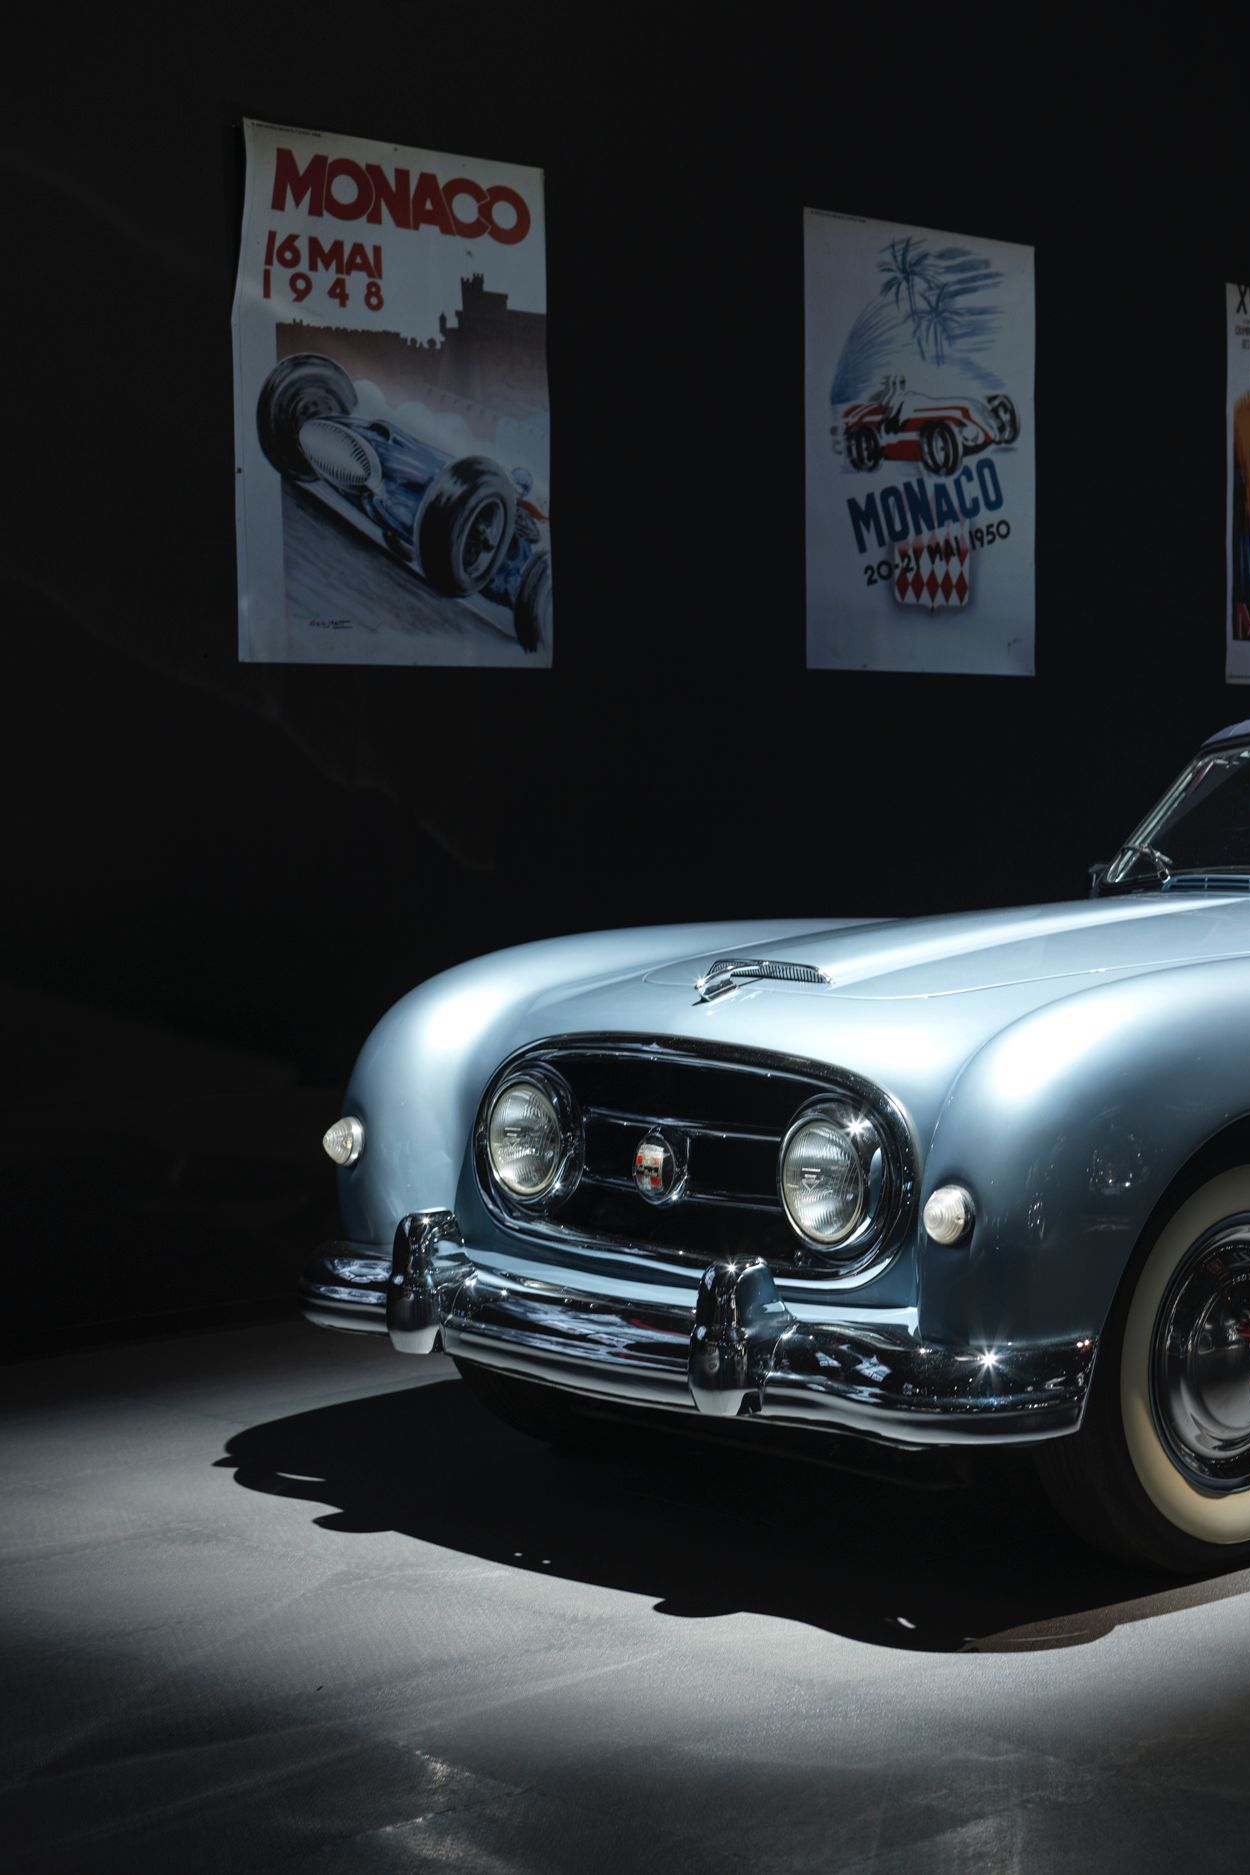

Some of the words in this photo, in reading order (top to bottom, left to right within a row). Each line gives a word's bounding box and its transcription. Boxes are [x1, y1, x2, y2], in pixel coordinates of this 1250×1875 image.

[271, 147, 531, 246] MONACO
[264, 230, 302, 269] 16
[308, 236, 383, 280] MAI
[262, 269, 385, 312] 1948
[846, 457, 1004, 555] MONACO
[926, 536, 963, 565] MAI
[968, 519, 1012, 551] 1950
